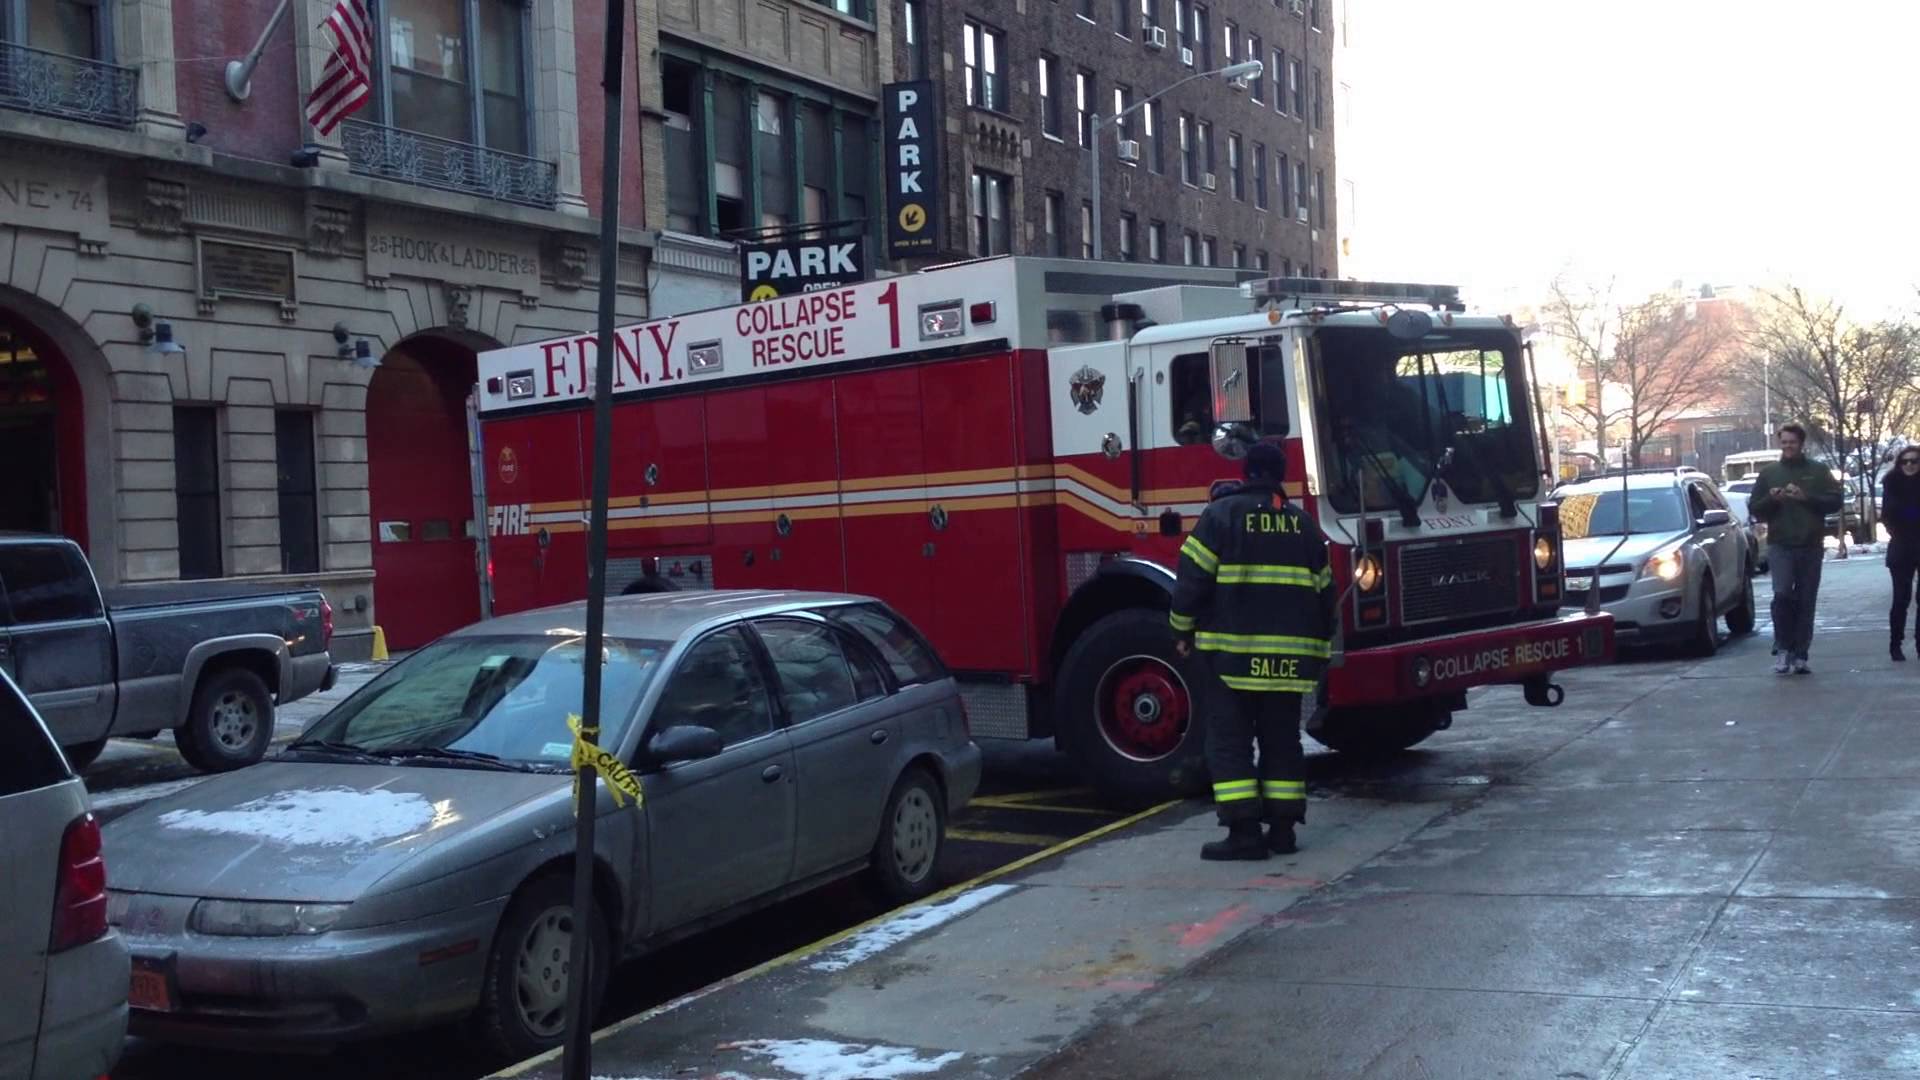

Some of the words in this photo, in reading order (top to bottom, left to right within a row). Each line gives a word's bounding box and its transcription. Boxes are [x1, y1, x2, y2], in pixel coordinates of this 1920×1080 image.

[898, 90, 923, 194] PARK
[747, 243, 858, 281] PARK
[736, 290, 857, 337] COLLAPSE
[878, 281, 901, 349] 1
[751, 326, 846, 368] RESCUE
[493, 503, 531, 537] FIRE
[1250, 657, 1300, 679] SALCE
[1434, 648, 1511, 681] COLLAPSE
[1514, 637, 1570, 666] RESCUE
[1576, 635, 1584, 654] 1
